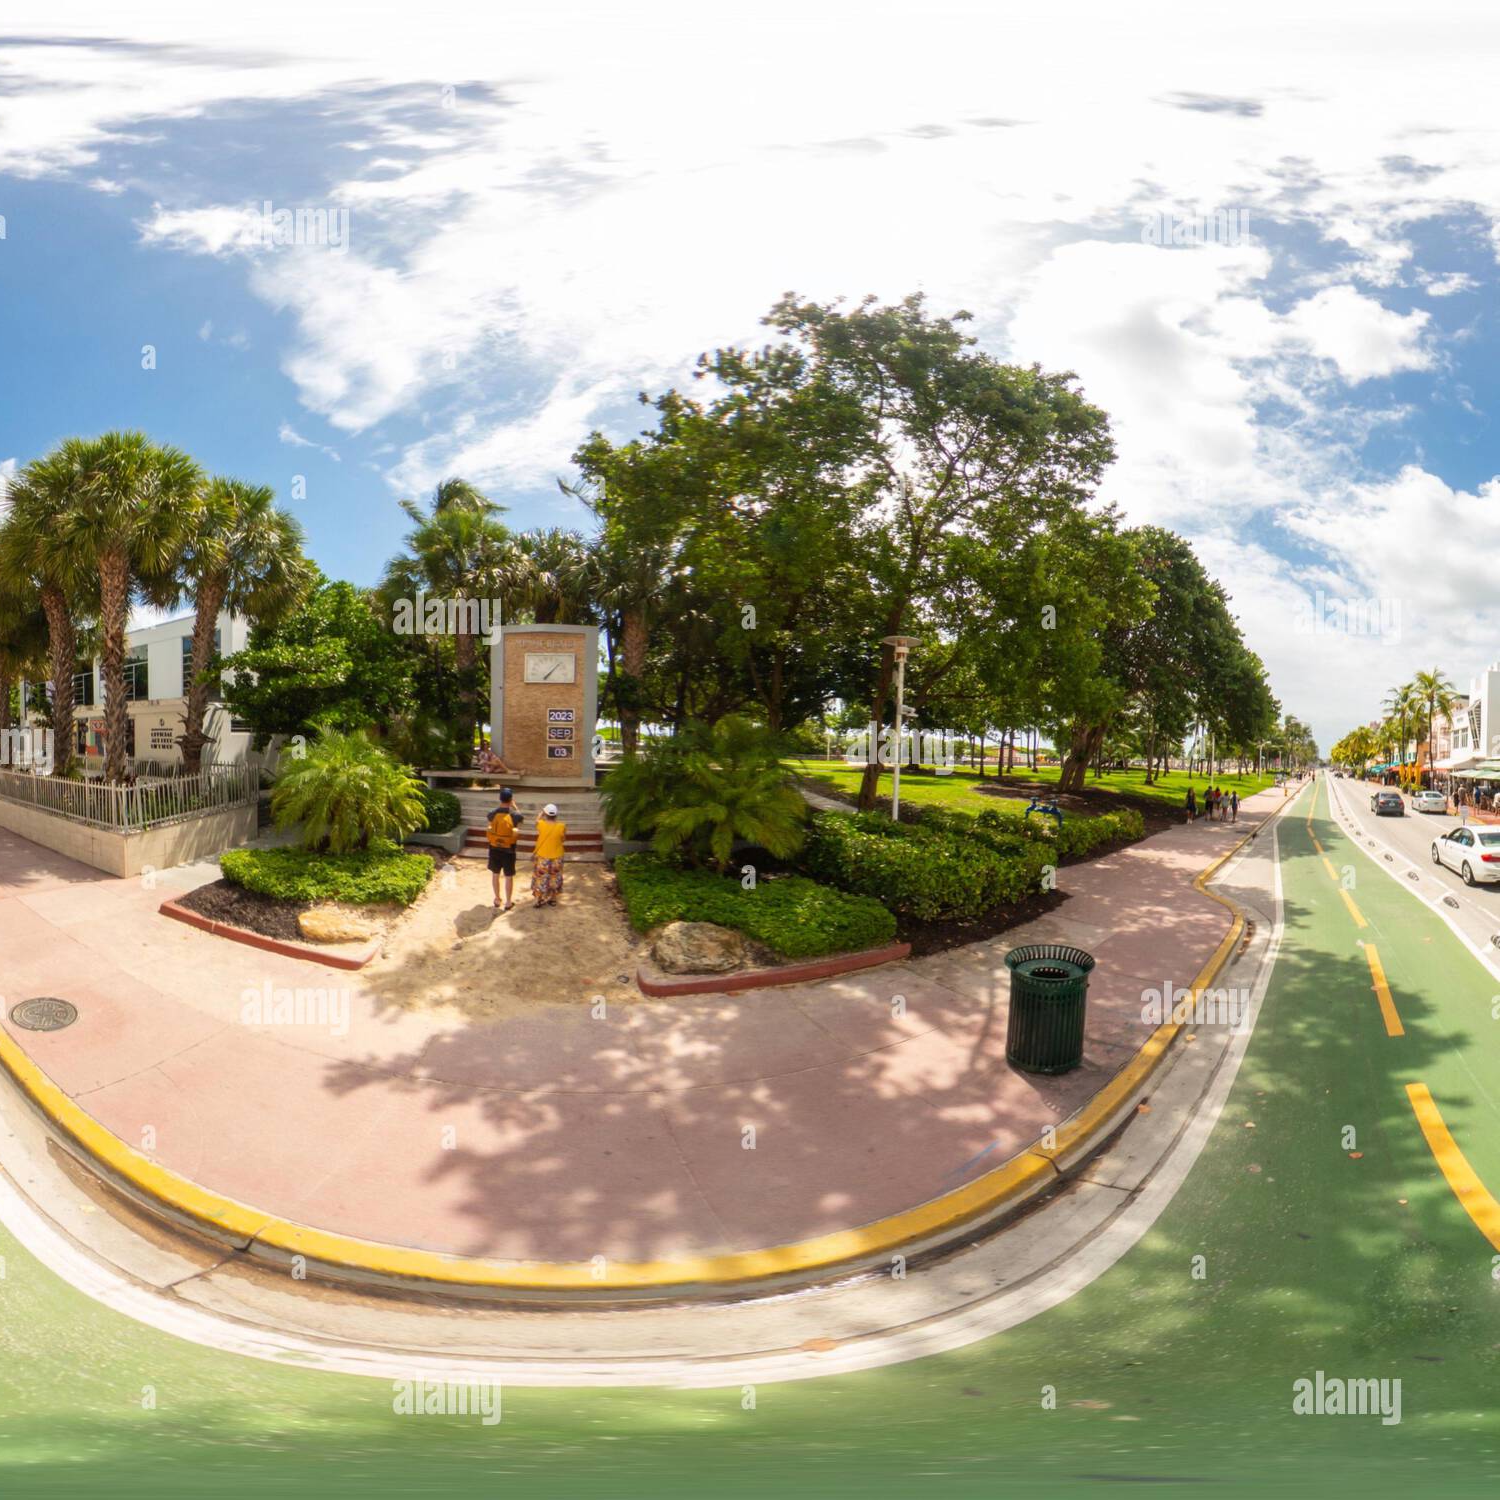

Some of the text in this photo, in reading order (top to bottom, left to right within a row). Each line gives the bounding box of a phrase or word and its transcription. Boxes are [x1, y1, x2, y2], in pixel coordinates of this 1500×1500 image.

[550, 711, 573, 721] 2023
[551, 729, 571, 738] SEP
[555, 748, 567, 757] 03
